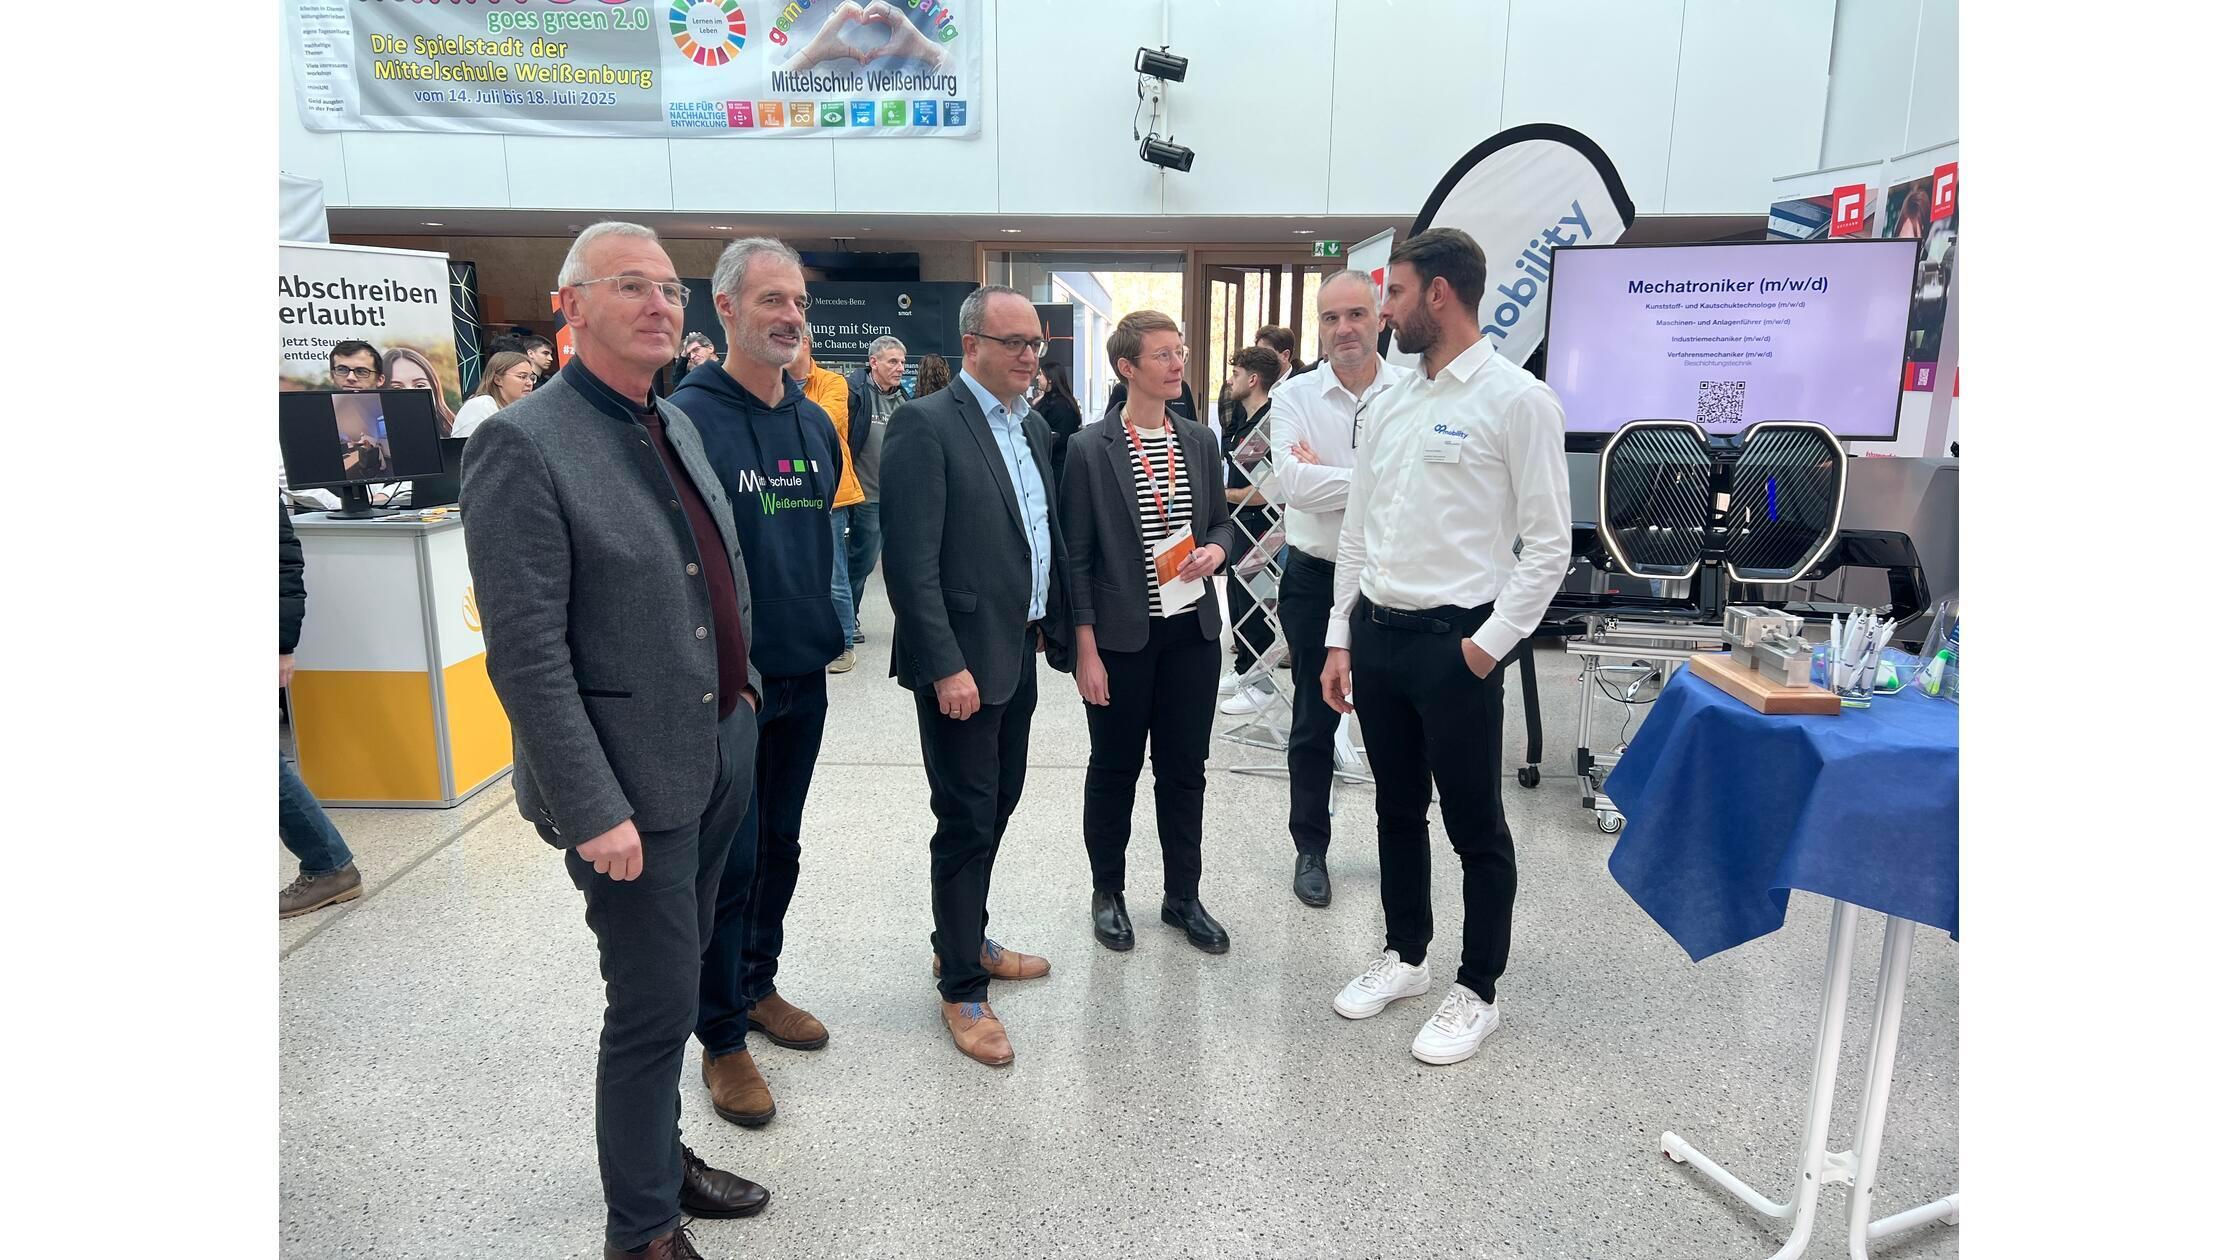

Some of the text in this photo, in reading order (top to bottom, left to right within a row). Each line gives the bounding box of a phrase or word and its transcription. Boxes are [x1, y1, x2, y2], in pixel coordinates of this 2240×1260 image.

[488, 7, 649, 34] goes green 2.0
[370, 34, 568, 59] Die Spielstadt der
[374, 59, 653, 89] Mittelschule Weißenburg
[771, 70, 957, 97] Mittelschule Weißenburg
[414, 90, 617, 105] vom 14. Juli bis 18. Juli 2025
[669, 101, 714, 111] ZIELE FÜR
[670, 112, 726, 120] NACHHALTIGE
[671, 120, 727, 128] ENTWICKLUNG
[279, 275, 438, 304] Abschreiben
[1628, 276, 1828, 295] Mechatroniker (m/w/d)
[815, 298, 866, 306] Mercedes-Benz
[1700, 302, 1776, 310] Kautschuktechnologe
[1778, 301, 1805, 309] (m/w/d)
[279, 302, 386, 327] erlaubt!
[1712, 318, 1762, 326] Anlagenführer
[1763, 318, 1791, 326] (m/w/d)
[840, 323, 861, 335] mit
[862, 323, 891, 335] Stern
[282, 337, 309, 347] Jetzt
[1672, 335, 1771, 343] Industriemechaniker (m/w/d)
[825, 340, 857, 349] Chance
[284, 351, 329, 361] entdeck
[1745, 351, 1773, 359] (m/w/d)
[760, 491, 823, 515] Weißenburg
